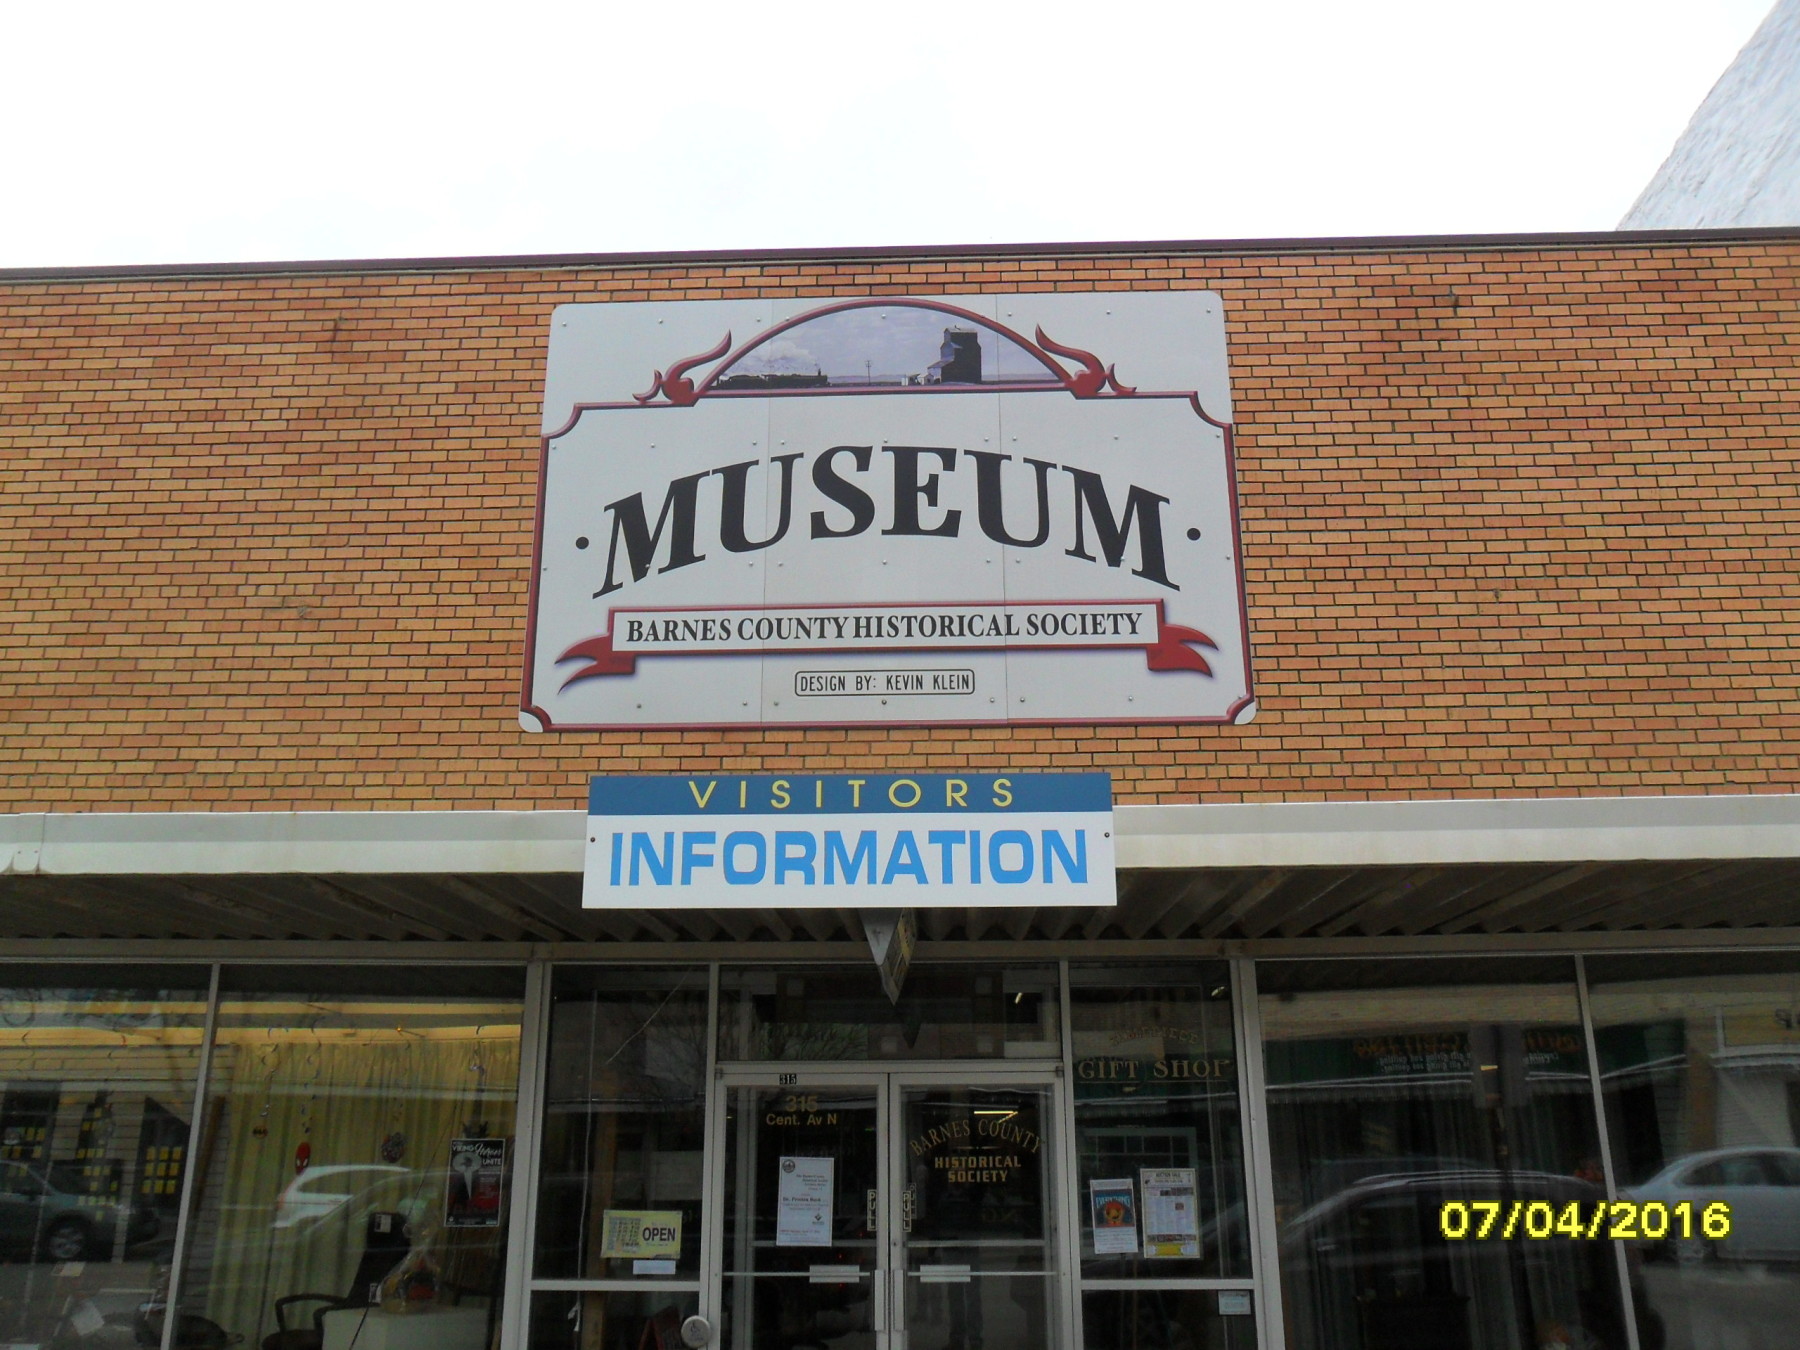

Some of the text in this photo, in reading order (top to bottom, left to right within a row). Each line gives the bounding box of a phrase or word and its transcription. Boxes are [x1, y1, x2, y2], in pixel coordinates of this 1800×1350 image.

[592, 445, 1181, 600] MUSEUM
[626, 612, 1143, 643] BARNES COUNTY HISTORICAL SOCIETY
[800, 674, 970, 692] DESIGN BY: KEVIN KLEIN
[688, 778, 1015, 809] VISITORS
[609, 828, 1088, 886] INFORMATION
[1078, 1059, 1139, 1079] GIFT
[779, 1073, 797, 1085] 315
[785, 1095, 818, 1112] 315
[766, 1112, 837, 1126] Cent. Av N
[909, 1119, 1041, 1156] BARNES COUNTY
[934, 1155, 1022, 1169] HISTORICAL
[947, 1169, 1009, 1183] SOCIETY
[642, 1227, 676, 1242] OPEN
